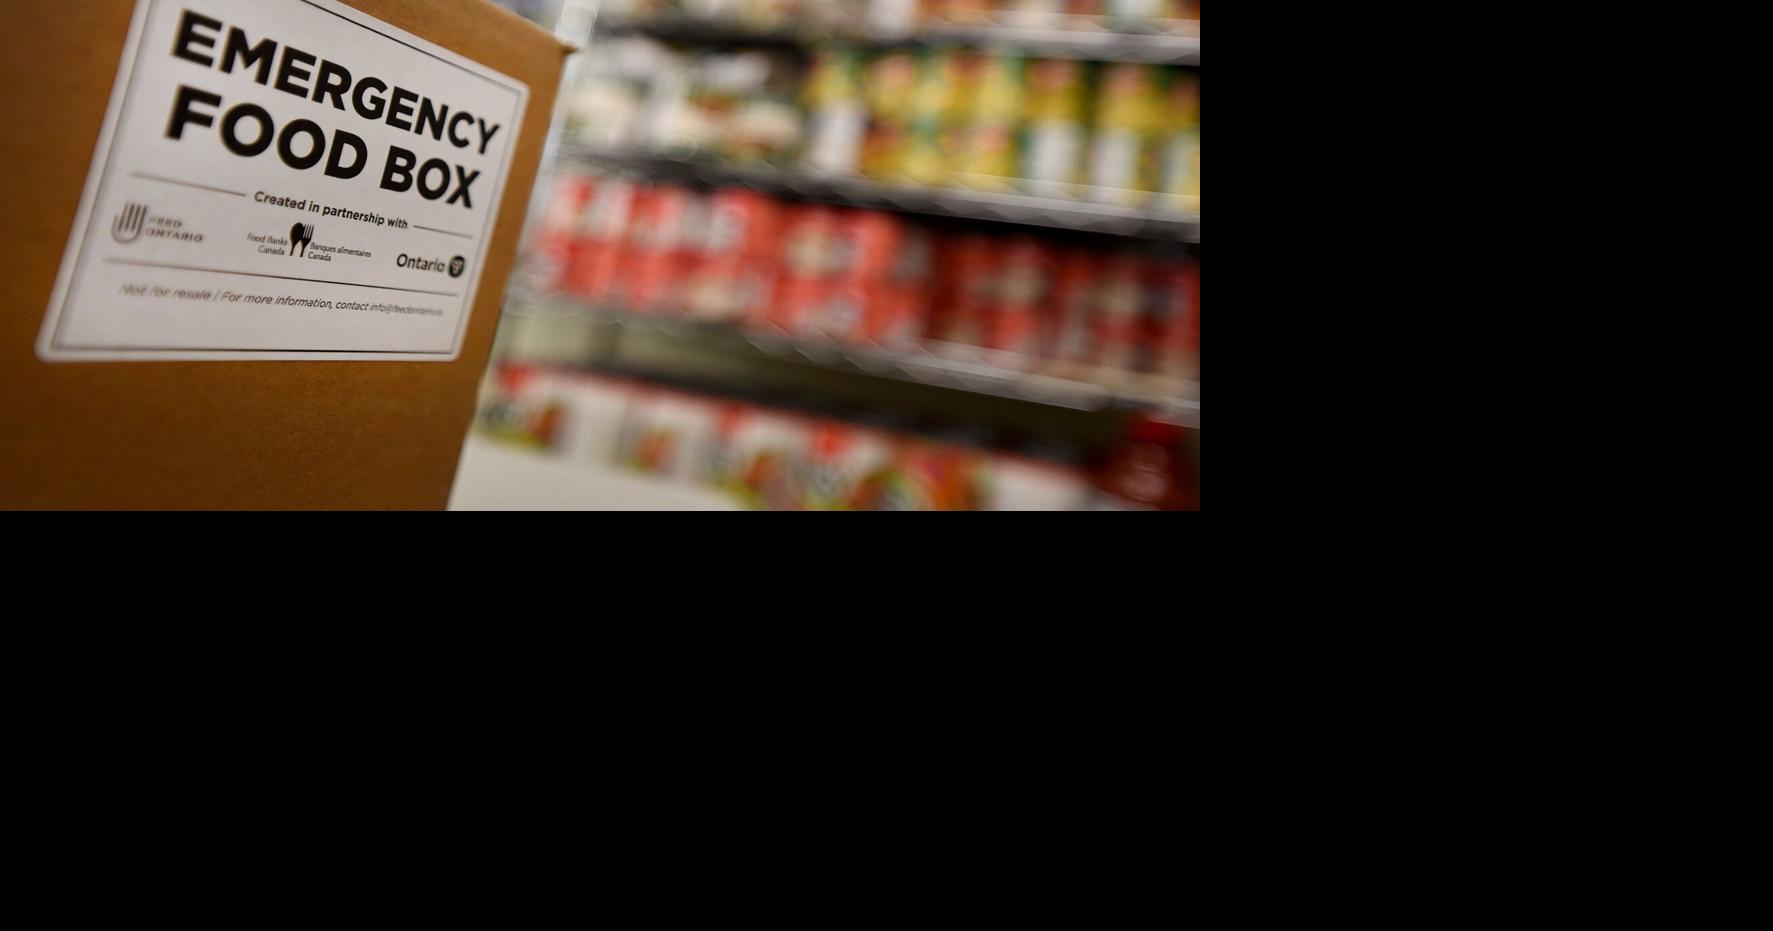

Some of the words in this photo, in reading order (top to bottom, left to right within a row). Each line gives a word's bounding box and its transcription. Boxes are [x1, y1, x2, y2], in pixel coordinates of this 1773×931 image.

[171, 8, 500, 155] EMERGENCY
[164, 84, 367, 180] FOOD
[379, 145, 480, 208] BOX
[254, 191, 305, 211] Created
[308, 200, 319, 213] in
[322, 206, 385, 226] partnership
[387, 216, 408, 229] with
[146, 228, 203, 243] ONTARIO
[247, 232, 266, 244] Food
[267, 235, 288, 246] Banks
[258, 245, 285, 256] Canada
[310, 241, 336, 254] Banques
[307, 251, 332, 262] Canada
[396, 253, 445, 273] Ontario
[173, 288, 211, 300] resale
[221, 291, 240, 302] For
[243, 295, 273, 305] more
[274, 295, 333, 310] information,
[335, 300, 369, 312] contact
